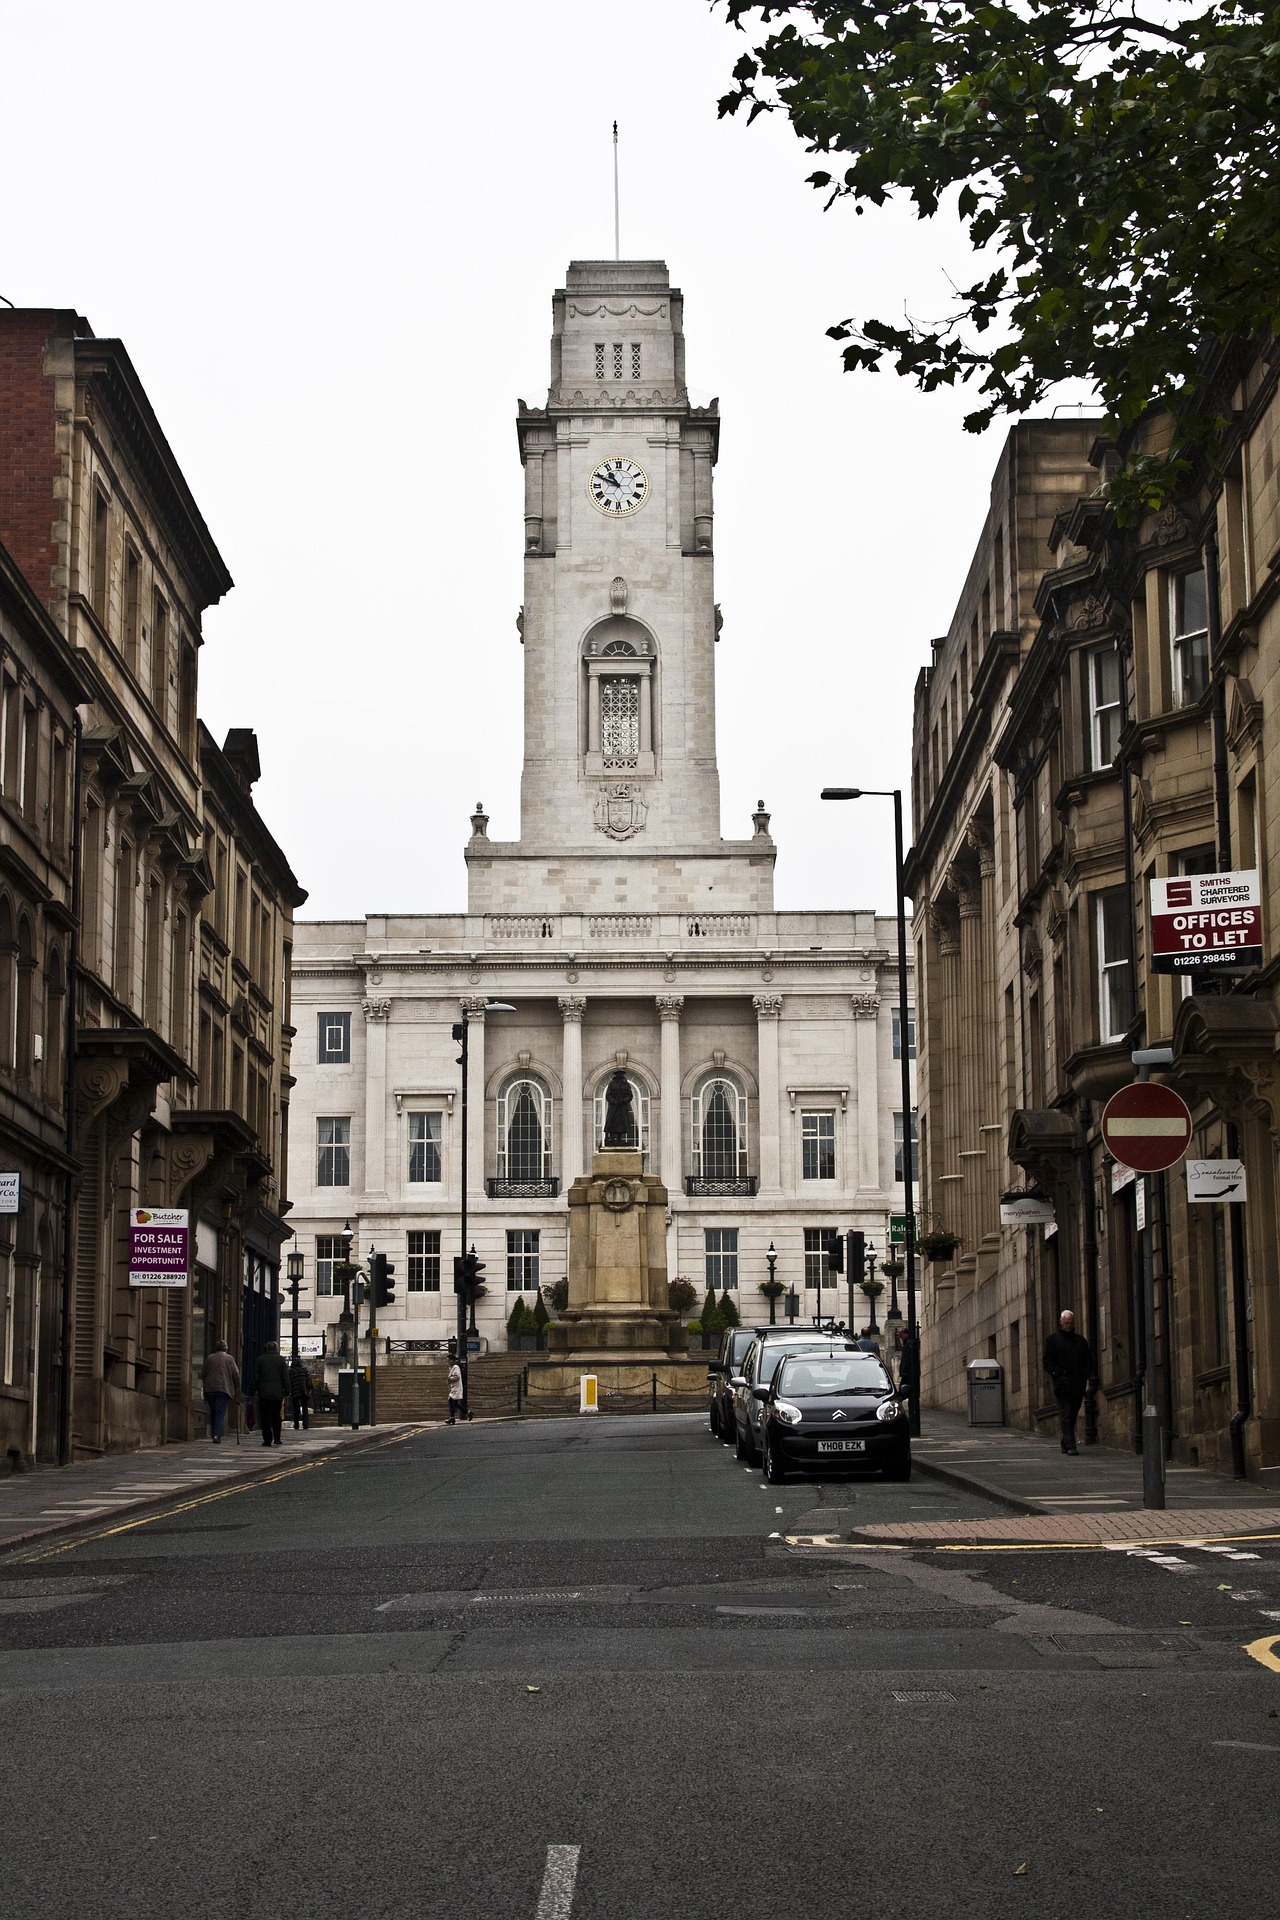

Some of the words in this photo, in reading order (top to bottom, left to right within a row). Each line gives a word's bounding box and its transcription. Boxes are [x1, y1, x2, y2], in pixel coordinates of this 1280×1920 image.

[1199, 878, 1231, 887] SMITHS
[1200, 885, 1250, 897] CHARTERED
[1200, 894, 1250, 905] SURVEYORS
[1173, 910, 1255, 931] OFFICES
[1180, 933, 1207, 949] TO
[1212, 929, 1249, 946] LET
[1173, 957, 1200, 966] 01226
[1202, 952, 1236, 964] 298456
[1189, 1162, 1243, 1180] Sensational
[0, 1178, 16, 1187] ard
[152, 1212, 184, 1221] Butcher
[134, 1233, 155, 1243] FOR
[157, 1234, 183, 1244] SALE
[134, 1246, 182, 1254] INVESTMENT
[131, 1257, 185, 1265] OPPORTUNITY
[821, 1441, 843, 1450] YH08
[845, 1441, 862, 1450] EZK
